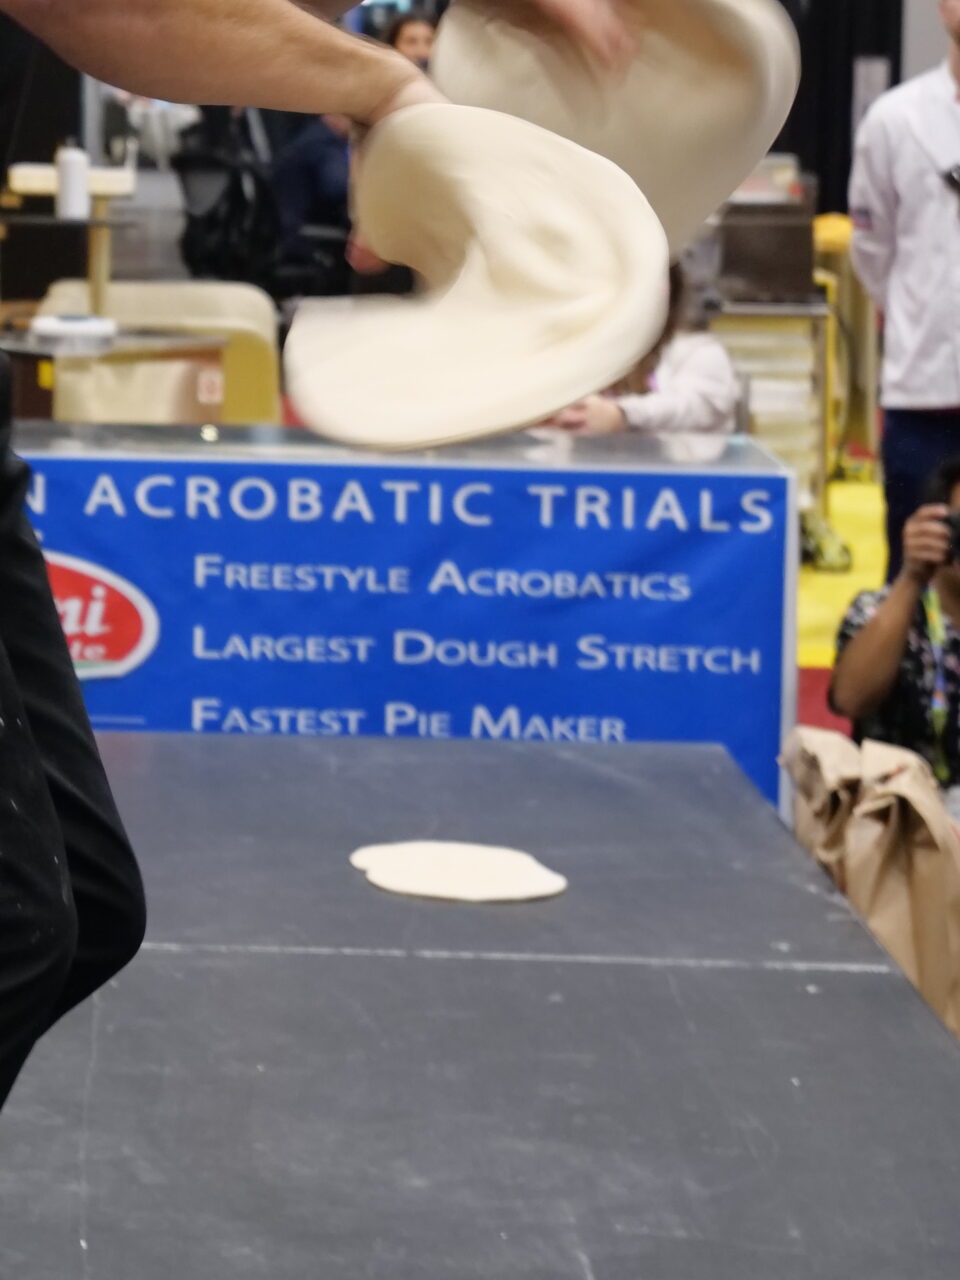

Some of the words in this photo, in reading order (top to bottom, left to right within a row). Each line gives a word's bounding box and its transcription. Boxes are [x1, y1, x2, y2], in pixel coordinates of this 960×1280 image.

[83, 473, 493, 526] ACROBATIC
[526, 484, 774, 534] TRIALS
[193, 554, 410, 594] FREESTYLE
[427, 560, 692, 602] ACROBATICS
[192, 624, 376, 663] LARGEST
[392, 628, 559, 669] DOUGH
[576, 633, 761, 675] STRETCH
[190, 697, 366, 736] FASTEST
[383, 701, 452, 739] PIE
[469, 705, 627, 744] MAKER
